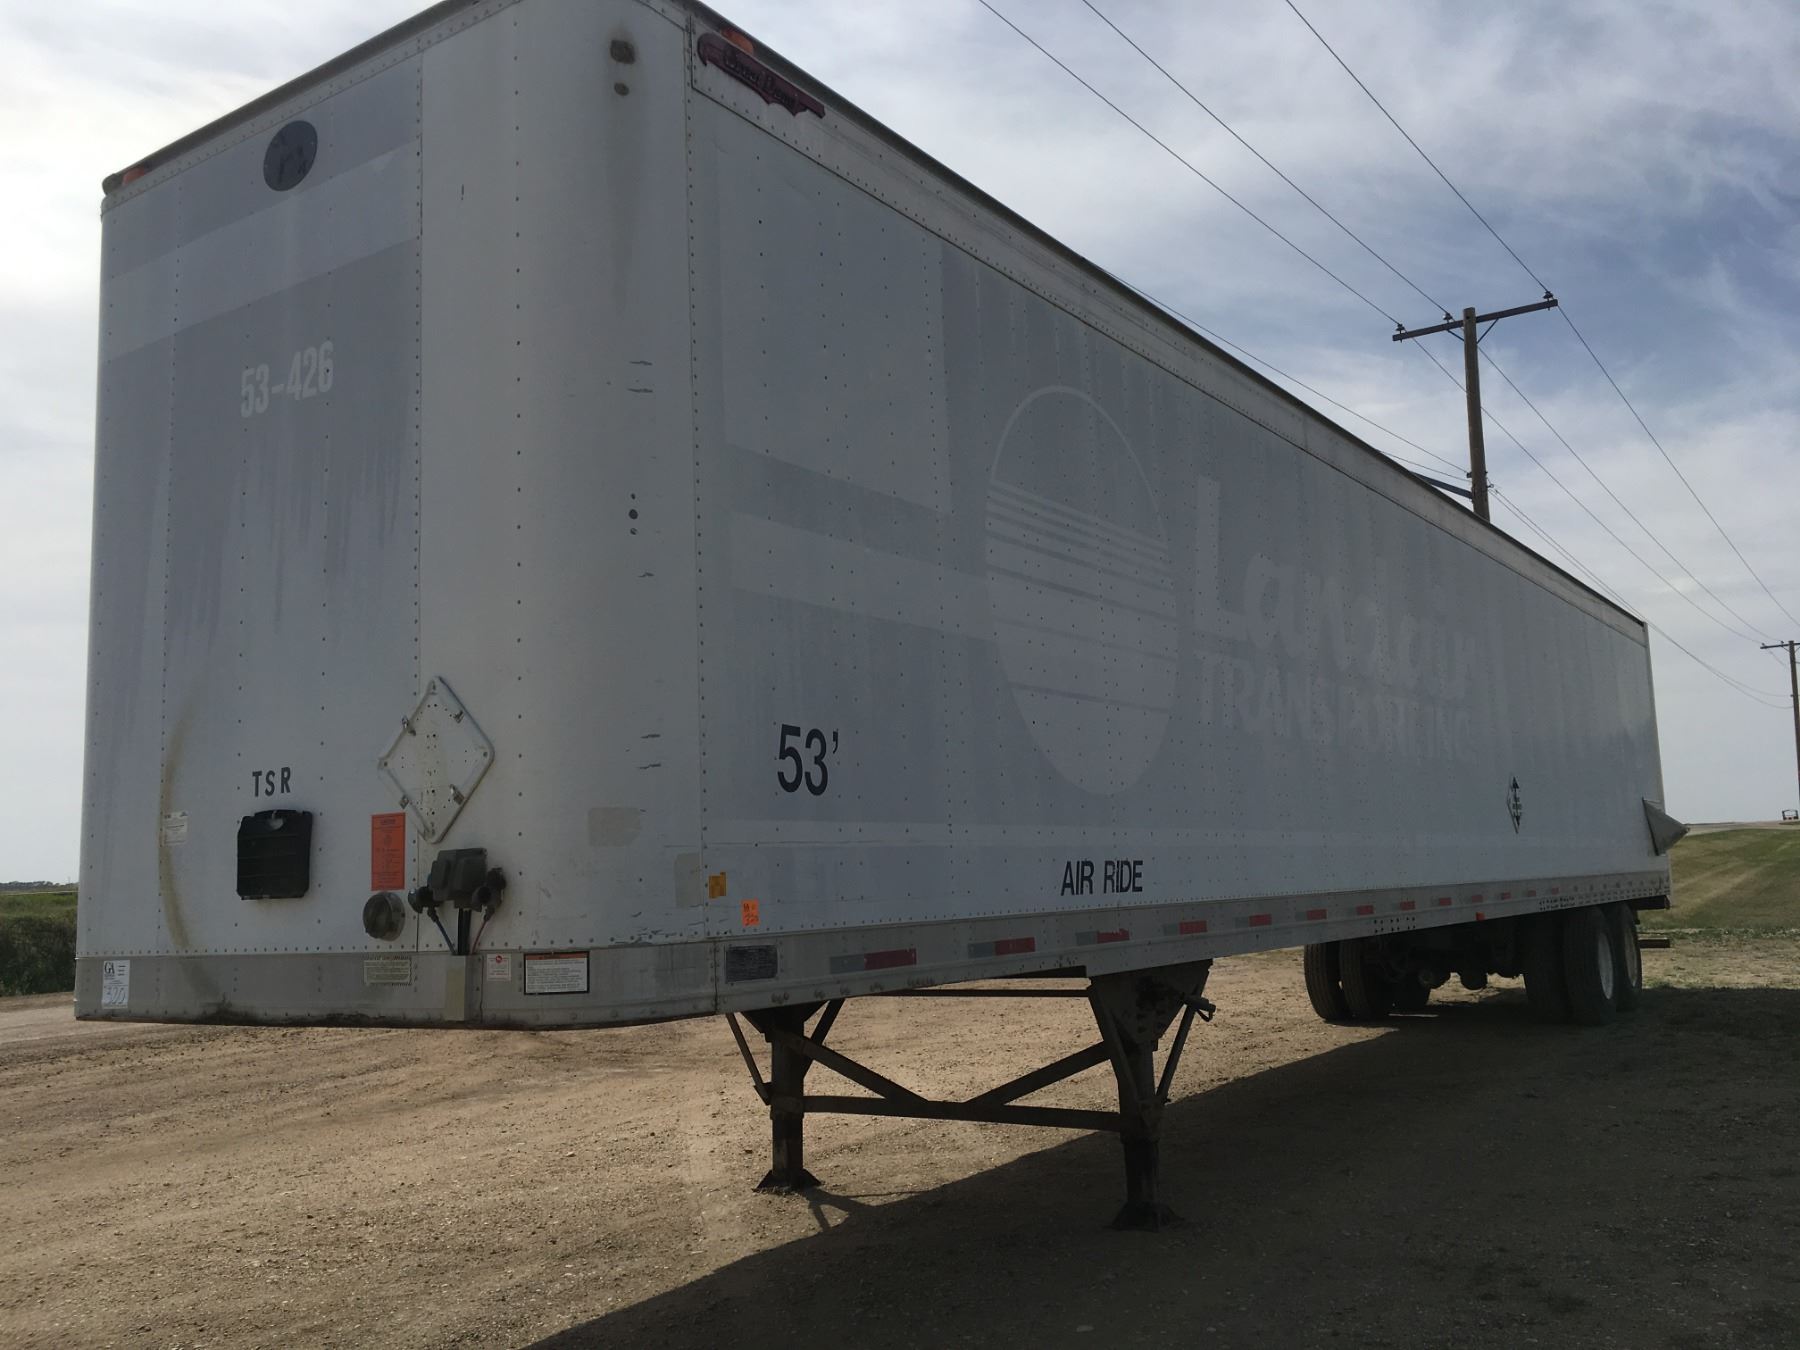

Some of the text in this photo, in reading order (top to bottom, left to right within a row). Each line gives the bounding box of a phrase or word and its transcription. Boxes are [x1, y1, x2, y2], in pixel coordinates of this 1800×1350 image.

[241, 341, 333, 417] 53-426
[252, 766, 291, 797] TSR
[777, 723, 839, 796] 53'
[1060, 860, 1143, 896] AIR RIDE
